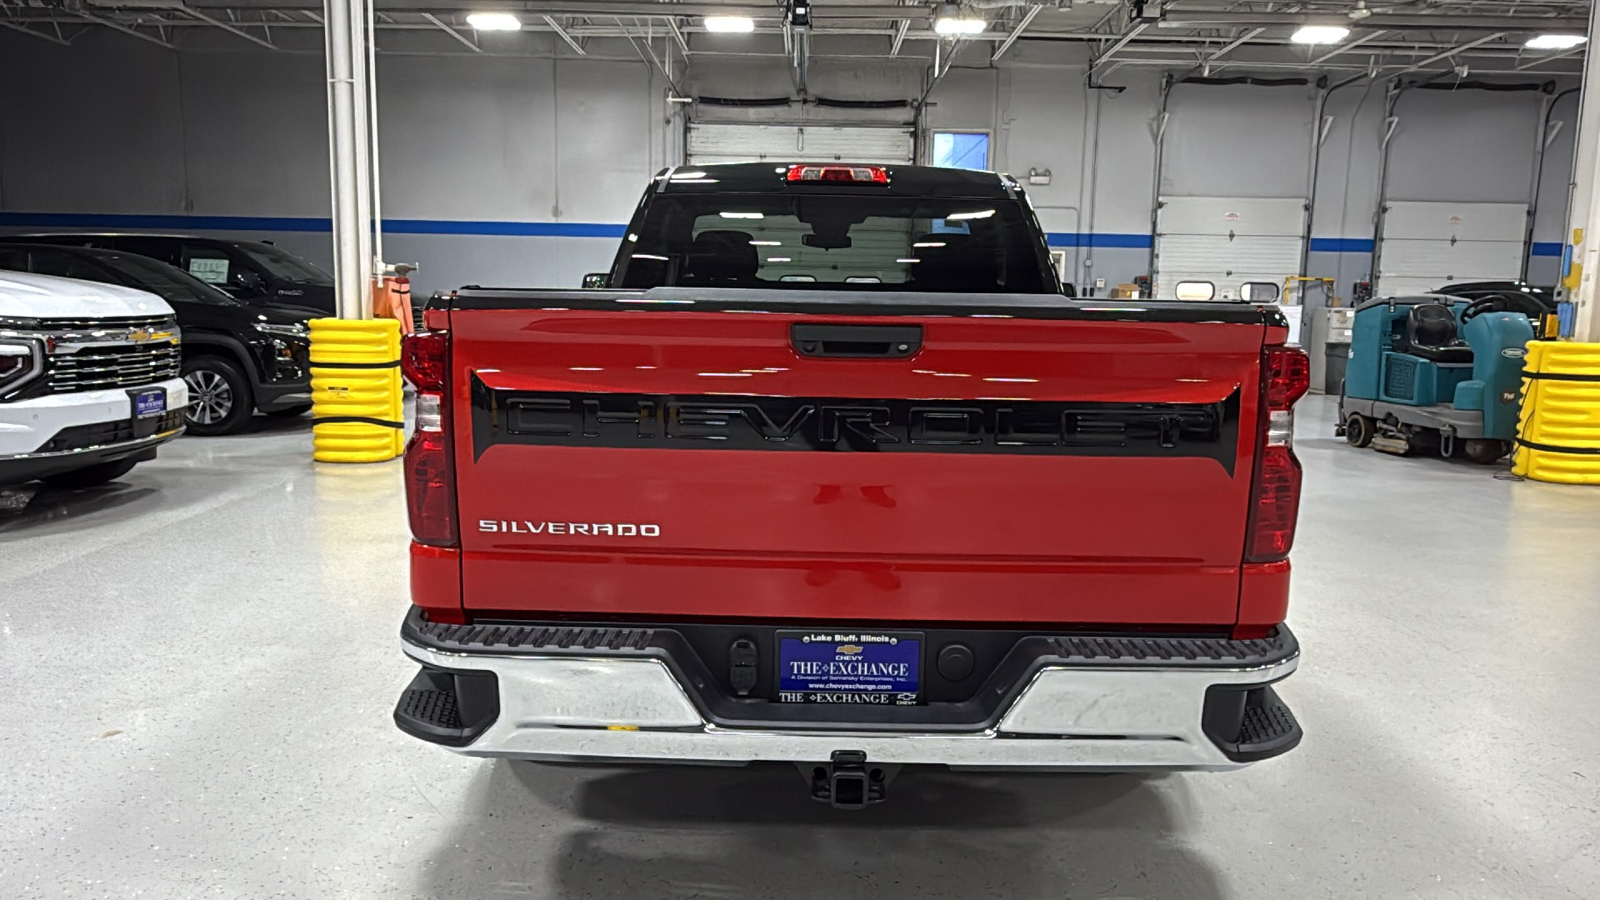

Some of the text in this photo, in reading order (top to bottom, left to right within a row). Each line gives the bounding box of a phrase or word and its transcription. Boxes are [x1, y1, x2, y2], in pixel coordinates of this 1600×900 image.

[506, 398, 1216, 448] CHEVROLET
[478, 519, 661, 537] SILVERADO
[811, 633, 832, 642] Lake
[860, 635, 890, 643] Illinois
[790, 661, 909, 676] THE EXCHANGE
[808, 682, 892, 691] www.chevyexchange.com
[779, 692, 889, 704] THE EXCHANGE
